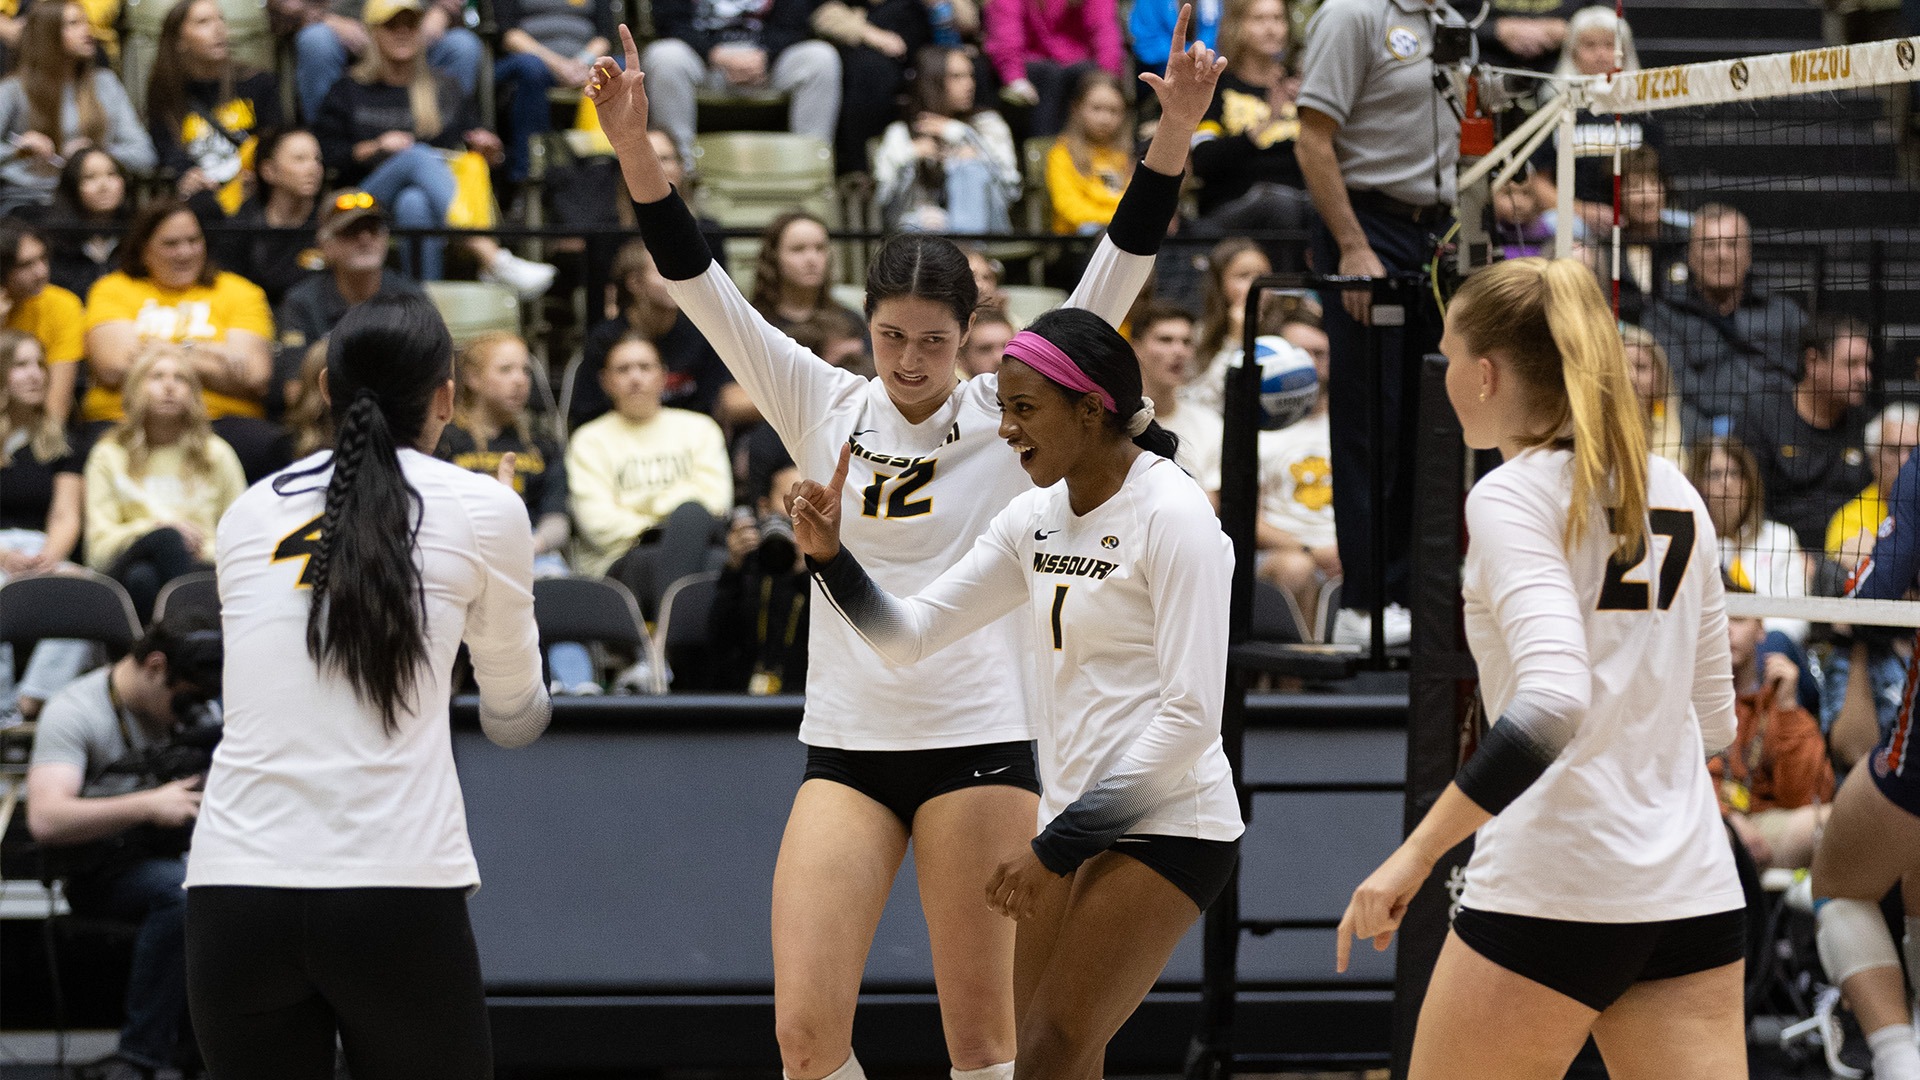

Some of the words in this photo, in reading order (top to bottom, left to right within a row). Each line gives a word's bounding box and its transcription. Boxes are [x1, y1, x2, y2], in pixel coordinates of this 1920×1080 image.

[1790, 48, 1849, 84] MIZZOU
[849, 420, 960, 468] MISSI
[861, 458, 938, 520] 12
[1595, 506, 1697, 613] 27
[1050, 583, 1070, 652] 1
